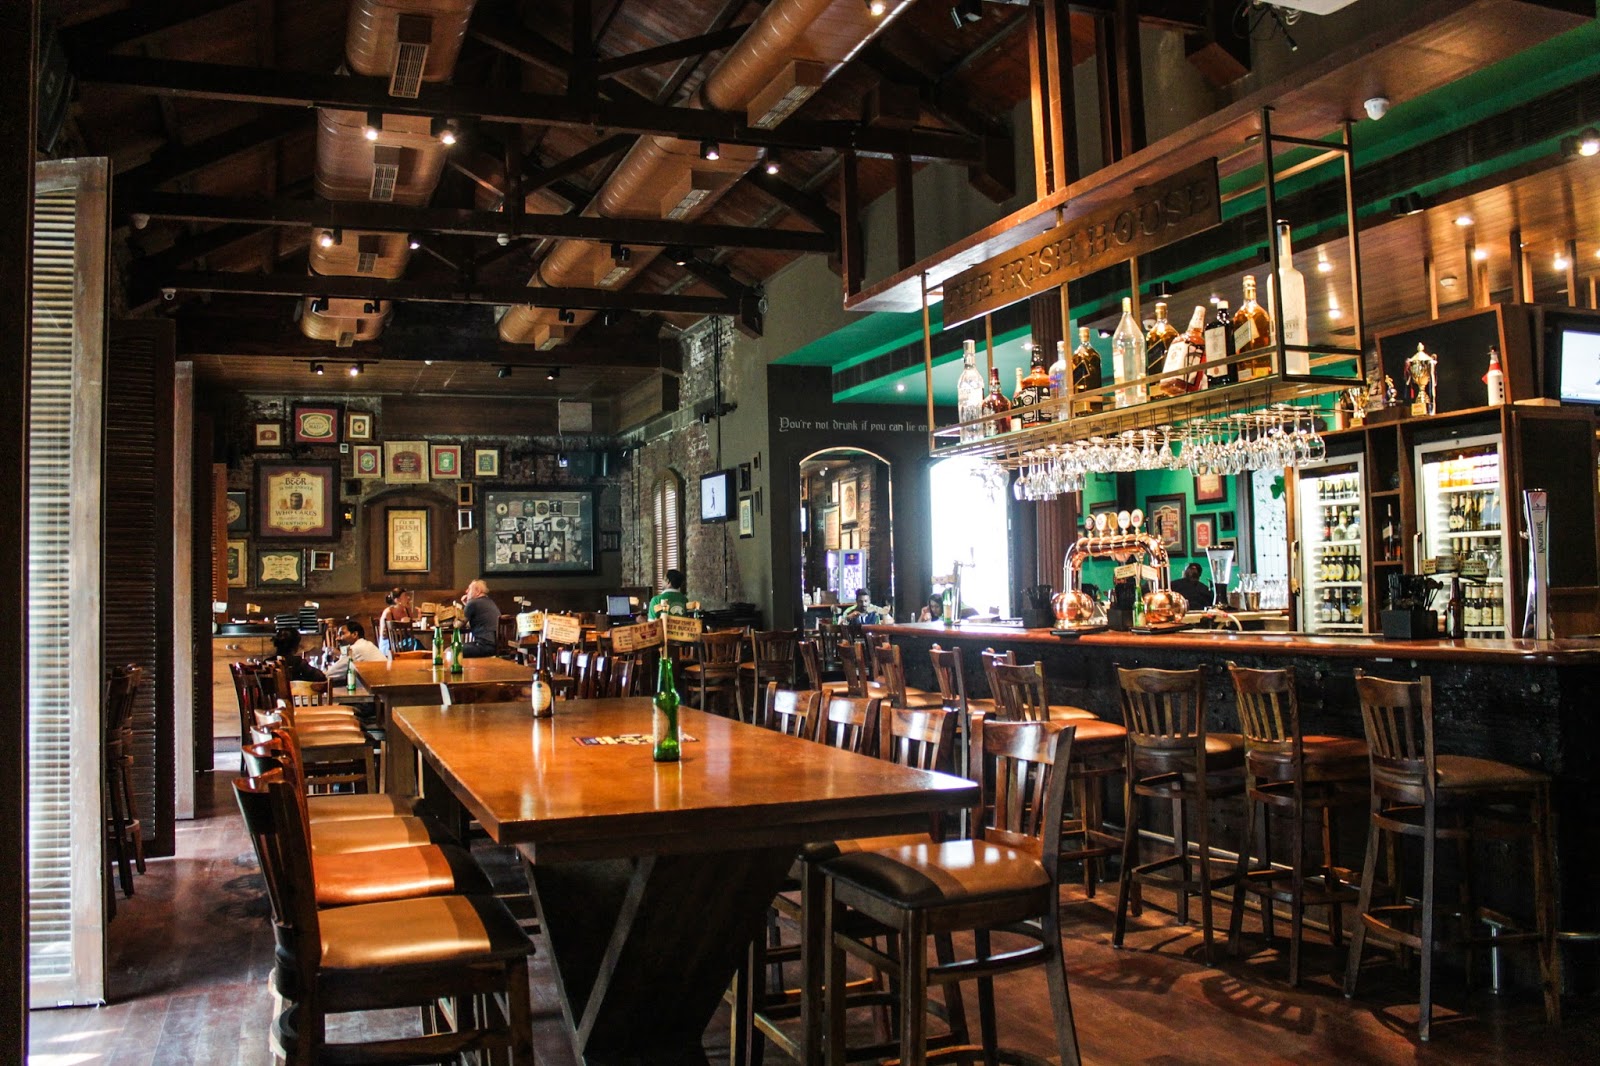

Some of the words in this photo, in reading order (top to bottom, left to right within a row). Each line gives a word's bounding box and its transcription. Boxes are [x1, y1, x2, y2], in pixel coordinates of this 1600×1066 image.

[999, 232, 1078, 293] IRISH
[1087, 180, 1211, 257] HOUSE
[815, 421, 829, 429] not
[832, 419, 858, 430] drunk
[861, 420, 868, 431] if
[870, 423, 886, 432] you
[889, 423, 903, 432] can
[906, 420, 915, 431] lie
[918, 424, 928, 432] on
[285, 477, 307, 486] BEER
